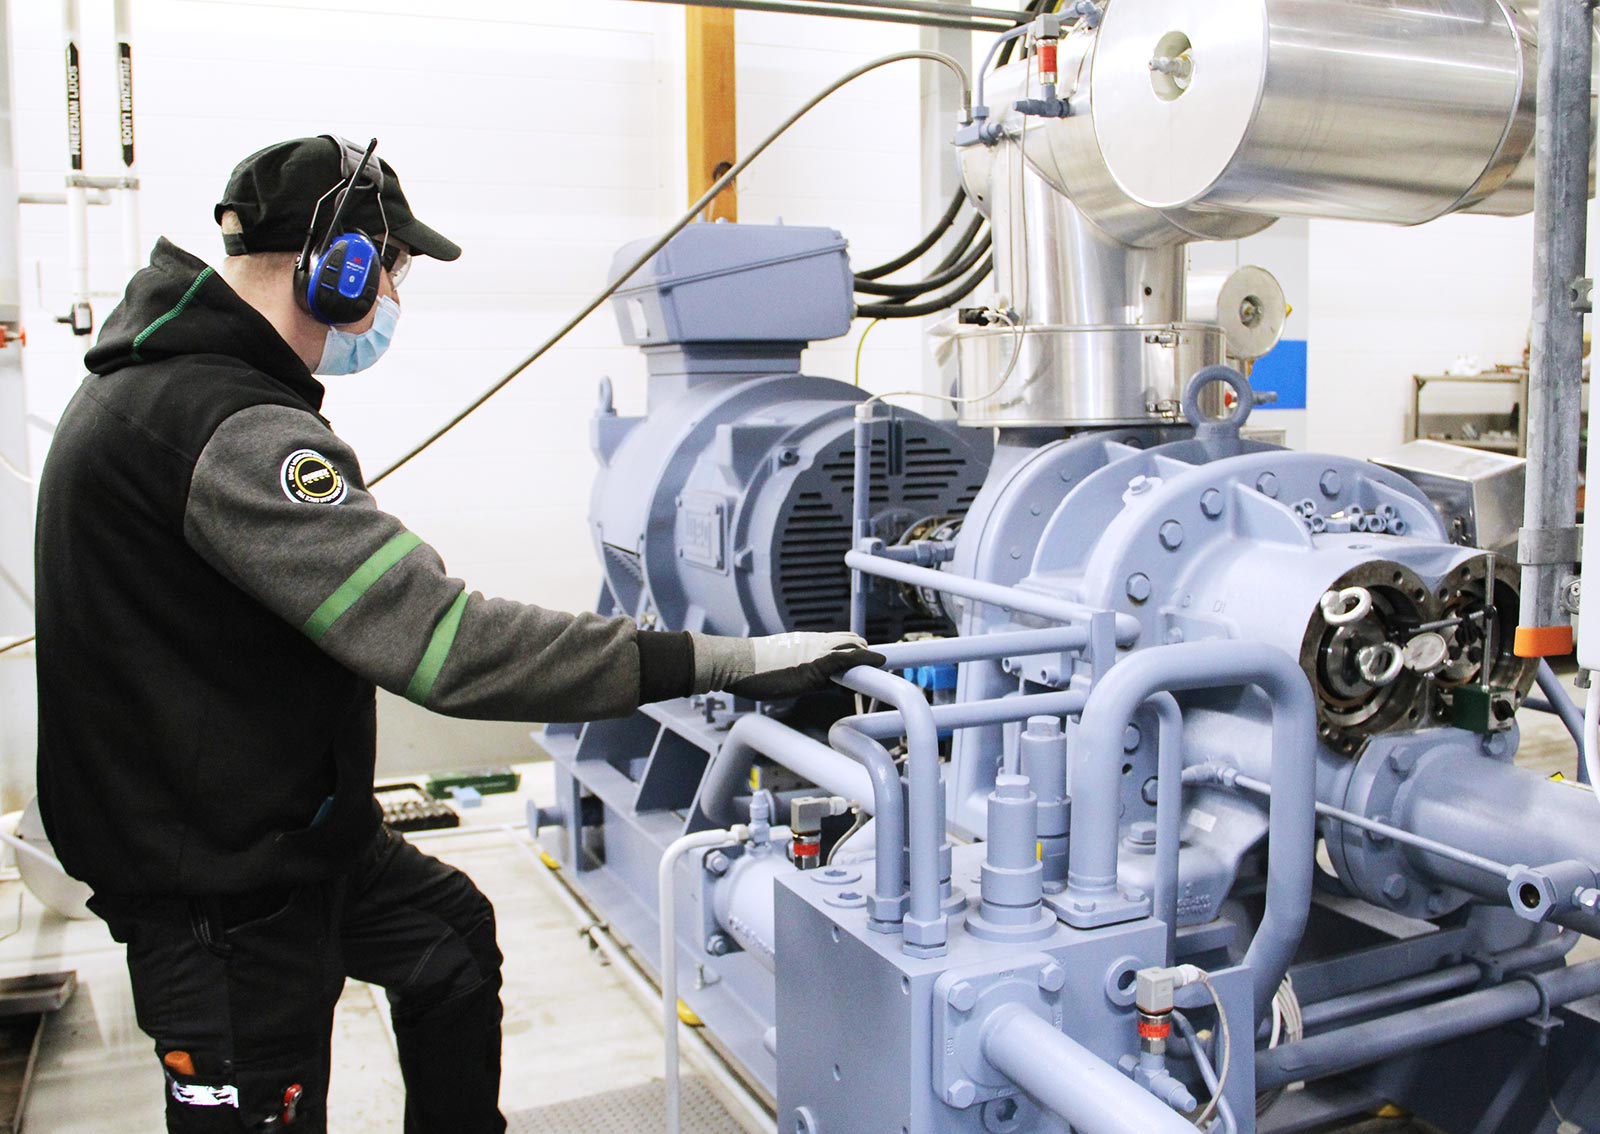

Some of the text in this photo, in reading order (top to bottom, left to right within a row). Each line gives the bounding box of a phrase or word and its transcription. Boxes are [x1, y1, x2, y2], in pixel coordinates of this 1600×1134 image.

[68, 65, 81, 155] FREEZIUM LIUOS
[120, 57, 133, 145] FREEZIUM LIUOS
